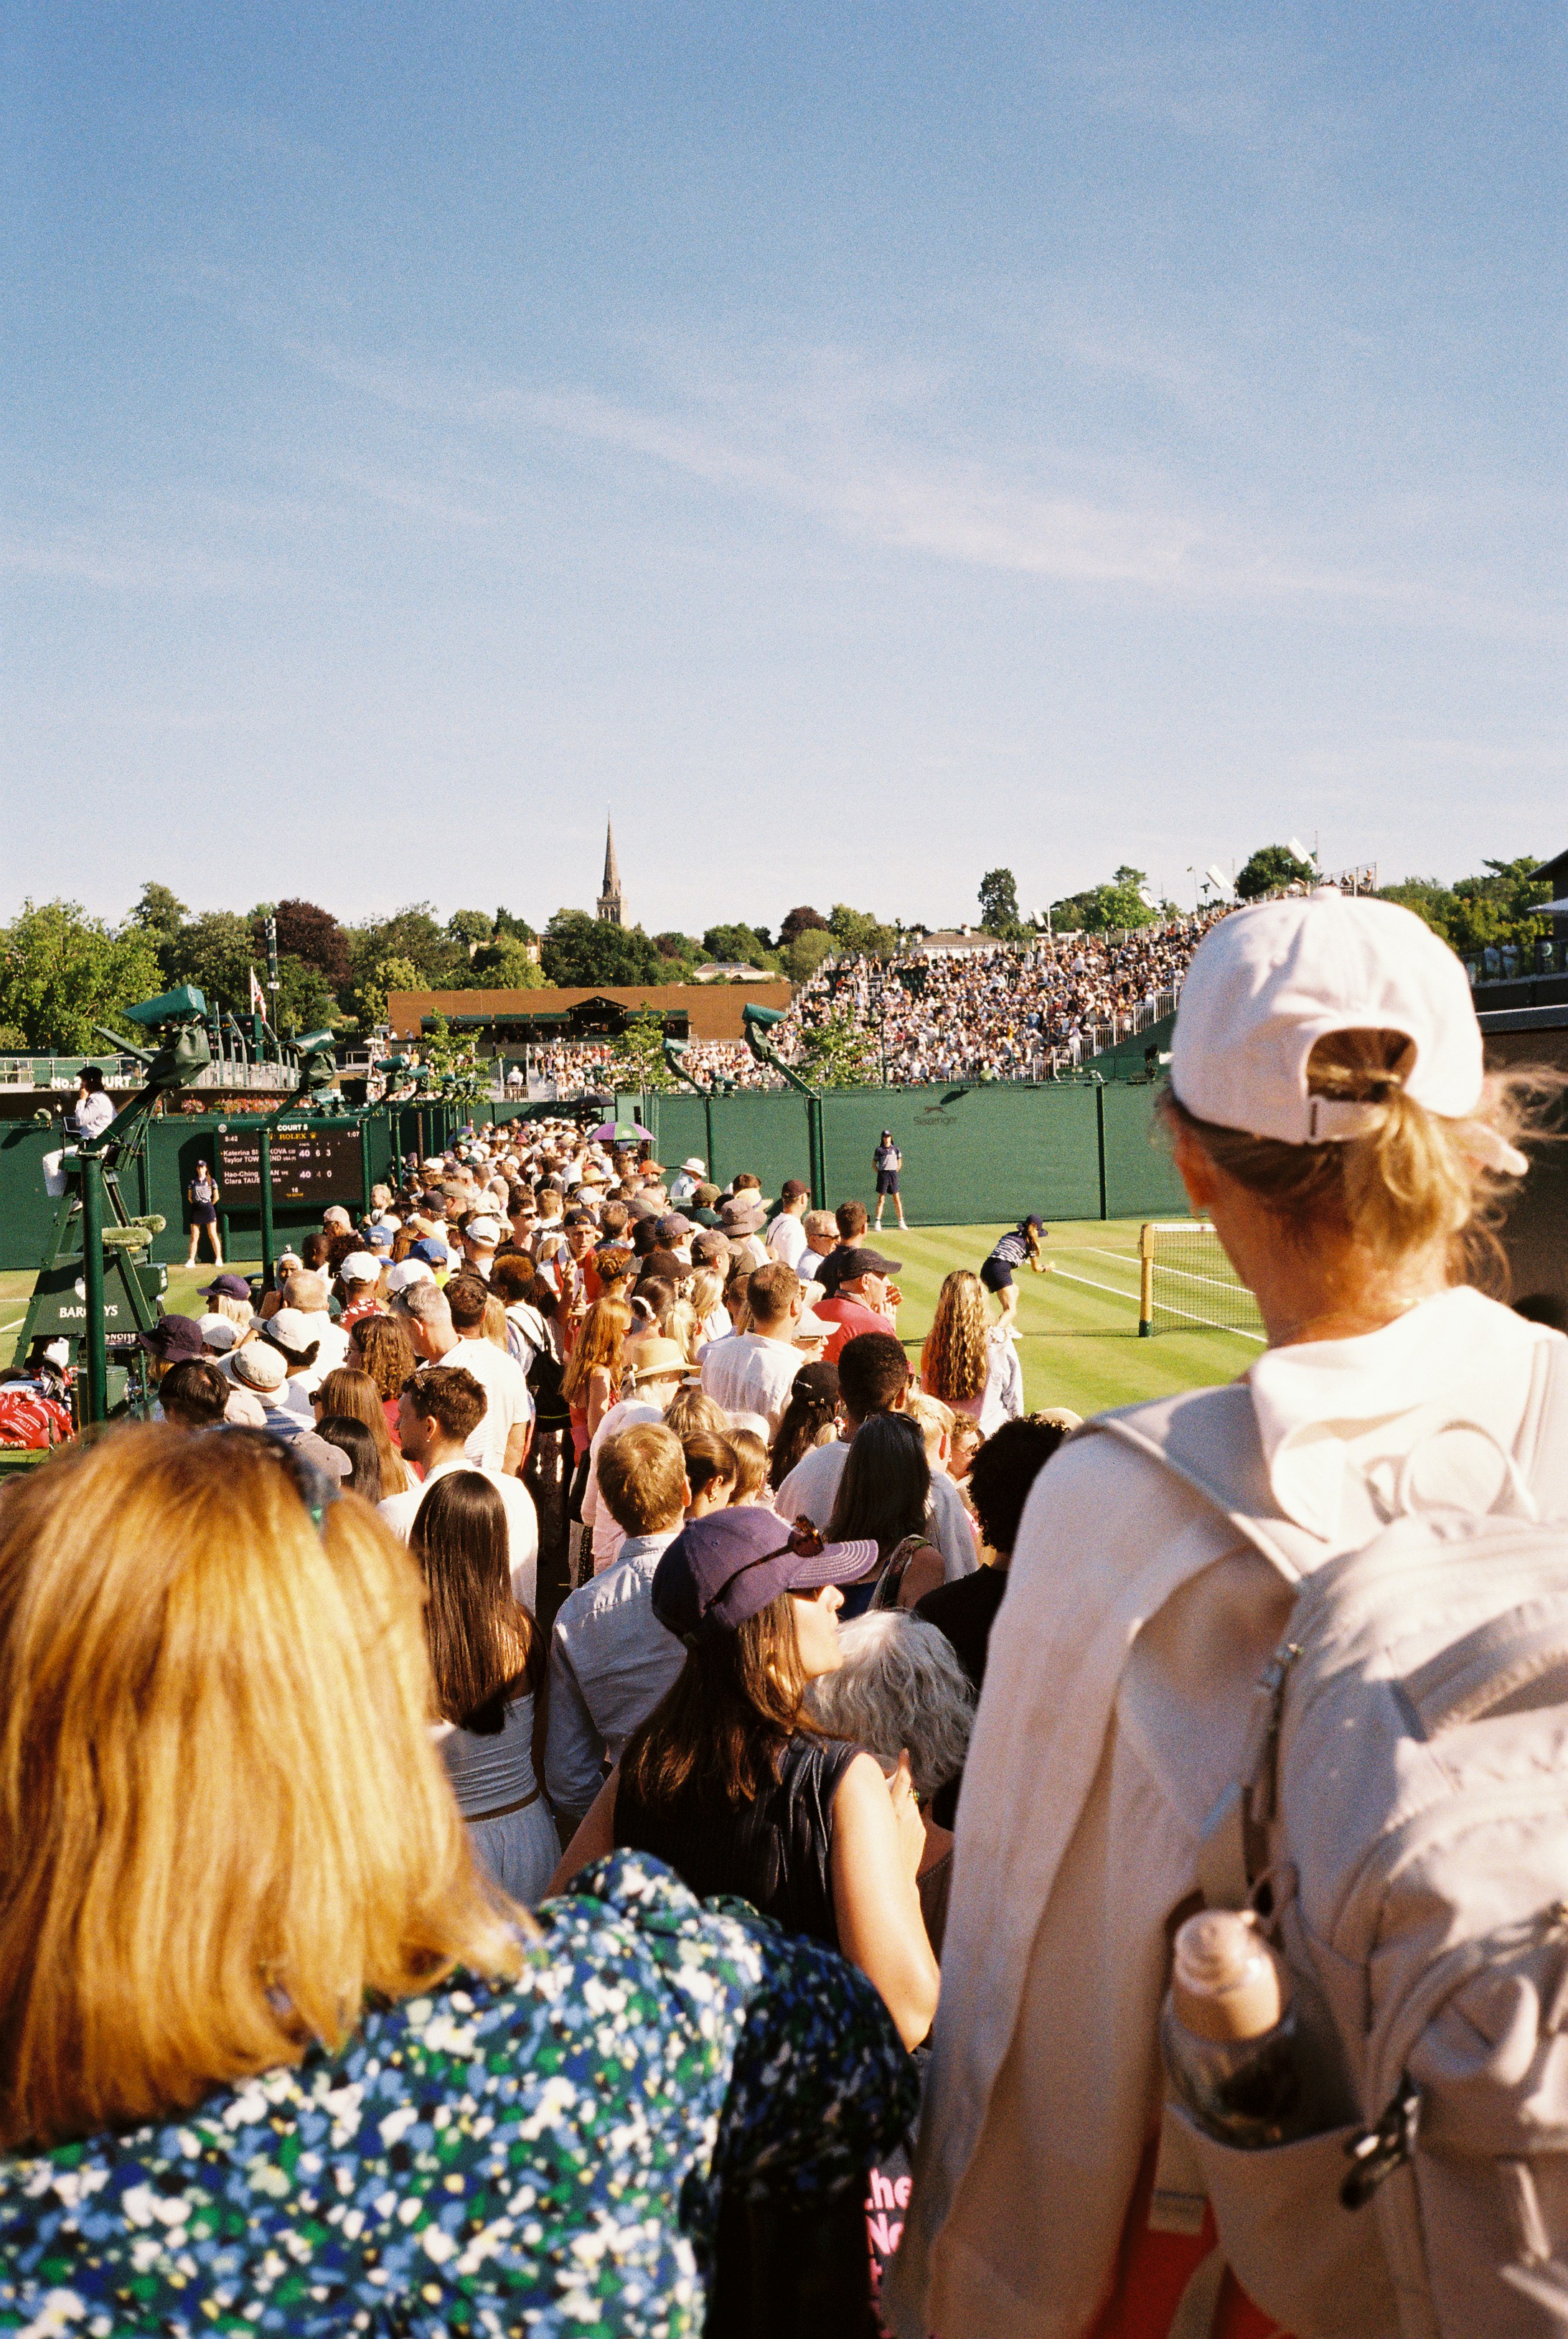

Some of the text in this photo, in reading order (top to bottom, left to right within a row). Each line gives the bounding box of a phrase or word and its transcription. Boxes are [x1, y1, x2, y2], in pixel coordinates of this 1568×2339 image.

[51, 1077, 82, 1089] No.2
[102, 1076, 131, 1088] URT
[60, 1305, 118, 1318] BARYS
